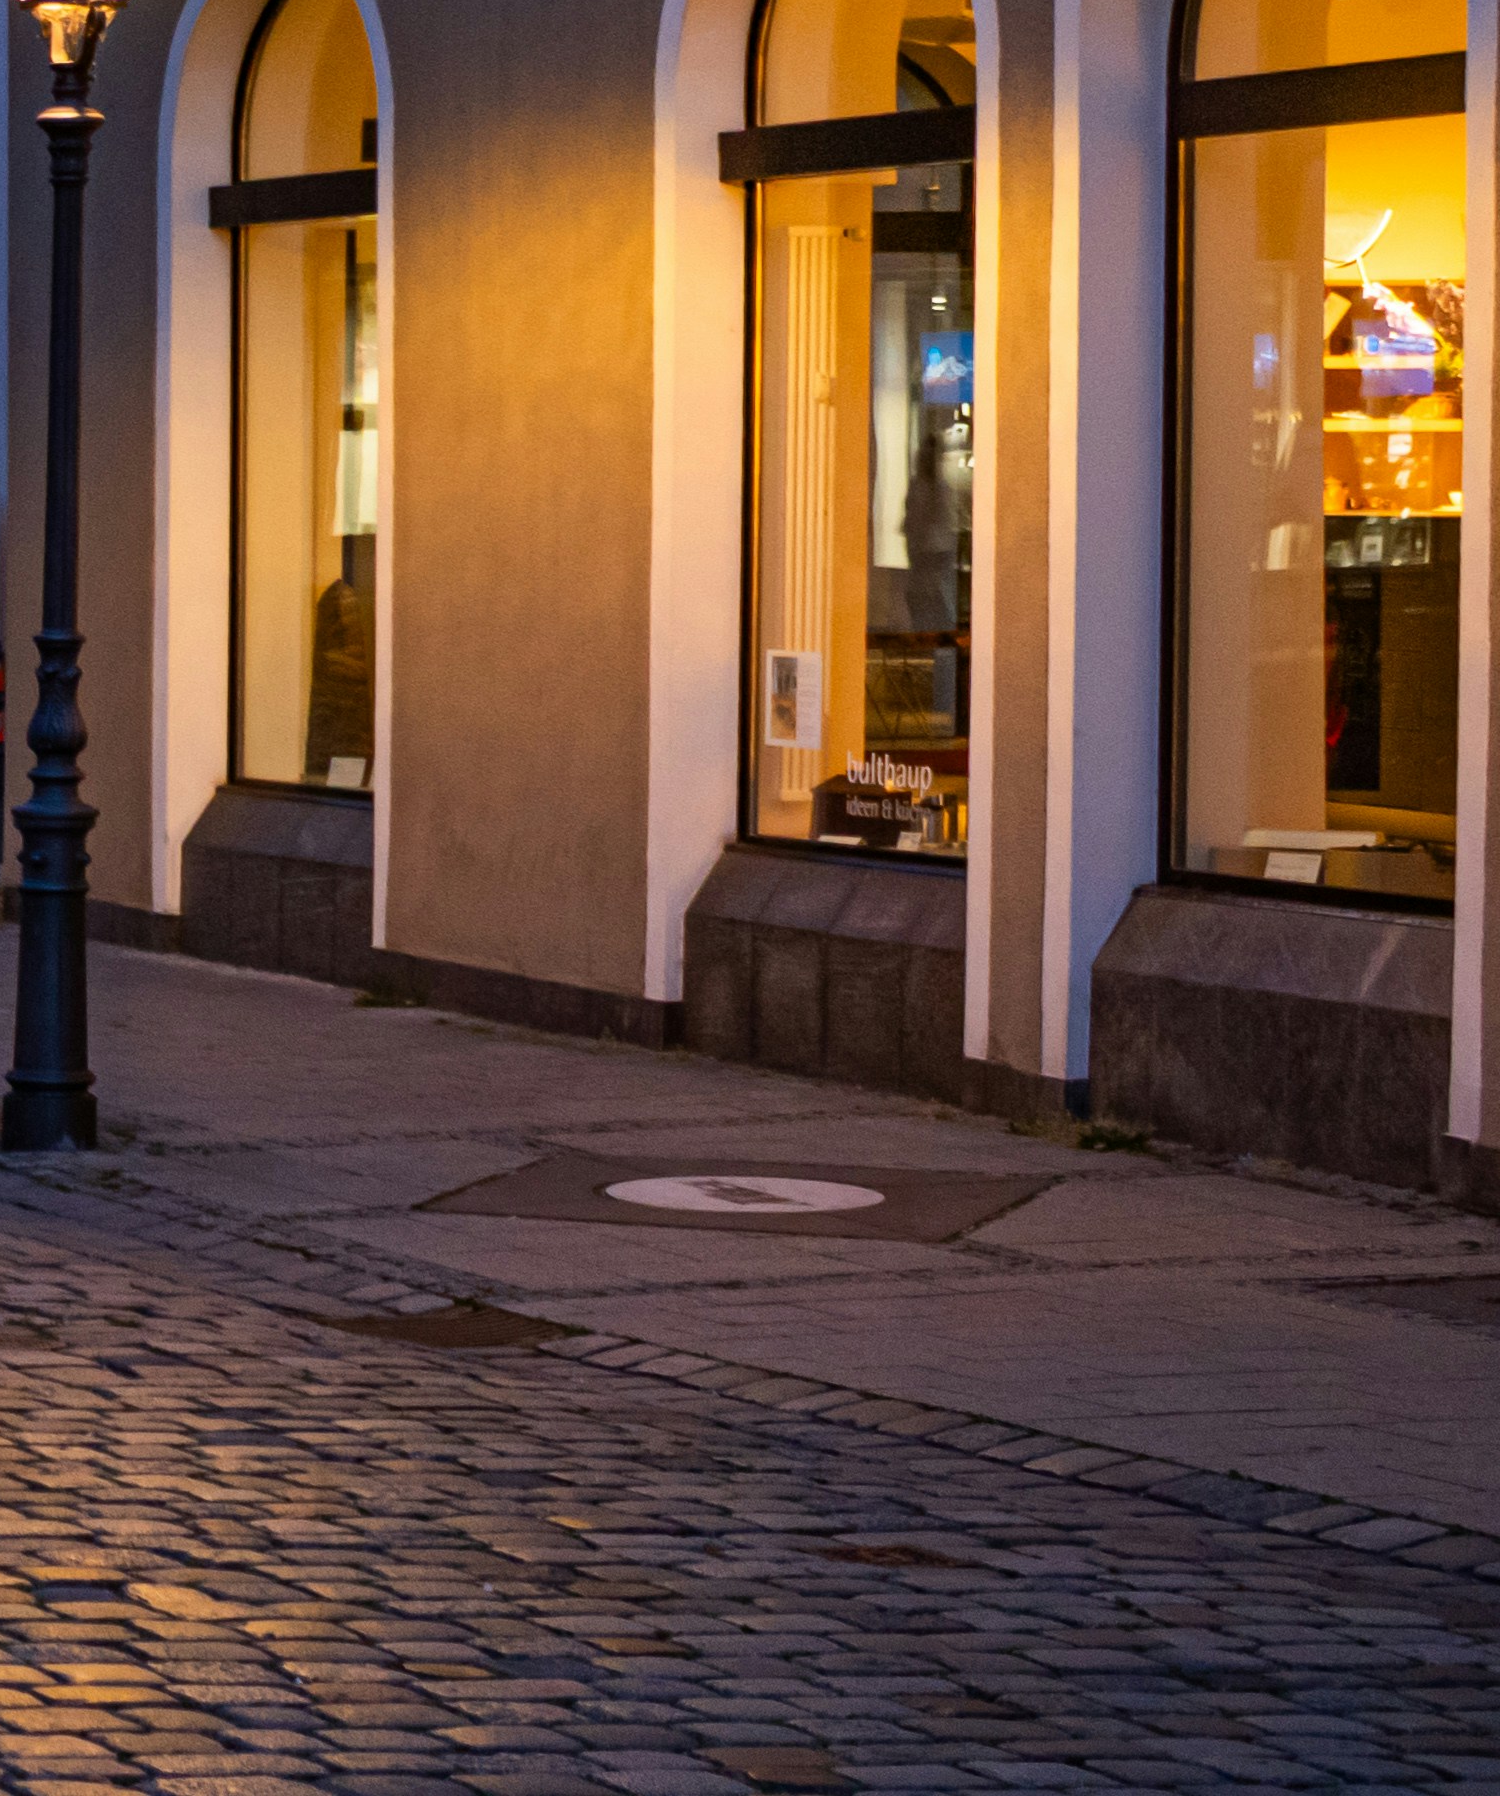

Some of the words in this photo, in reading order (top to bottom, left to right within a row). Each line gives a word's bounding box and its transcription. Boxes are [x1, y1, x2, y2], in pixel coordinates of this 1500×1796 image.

[846, 750, 933, 798] bulthaup
[846, 795, 879, 818] ideen
[881, 798, 893, 820] &
